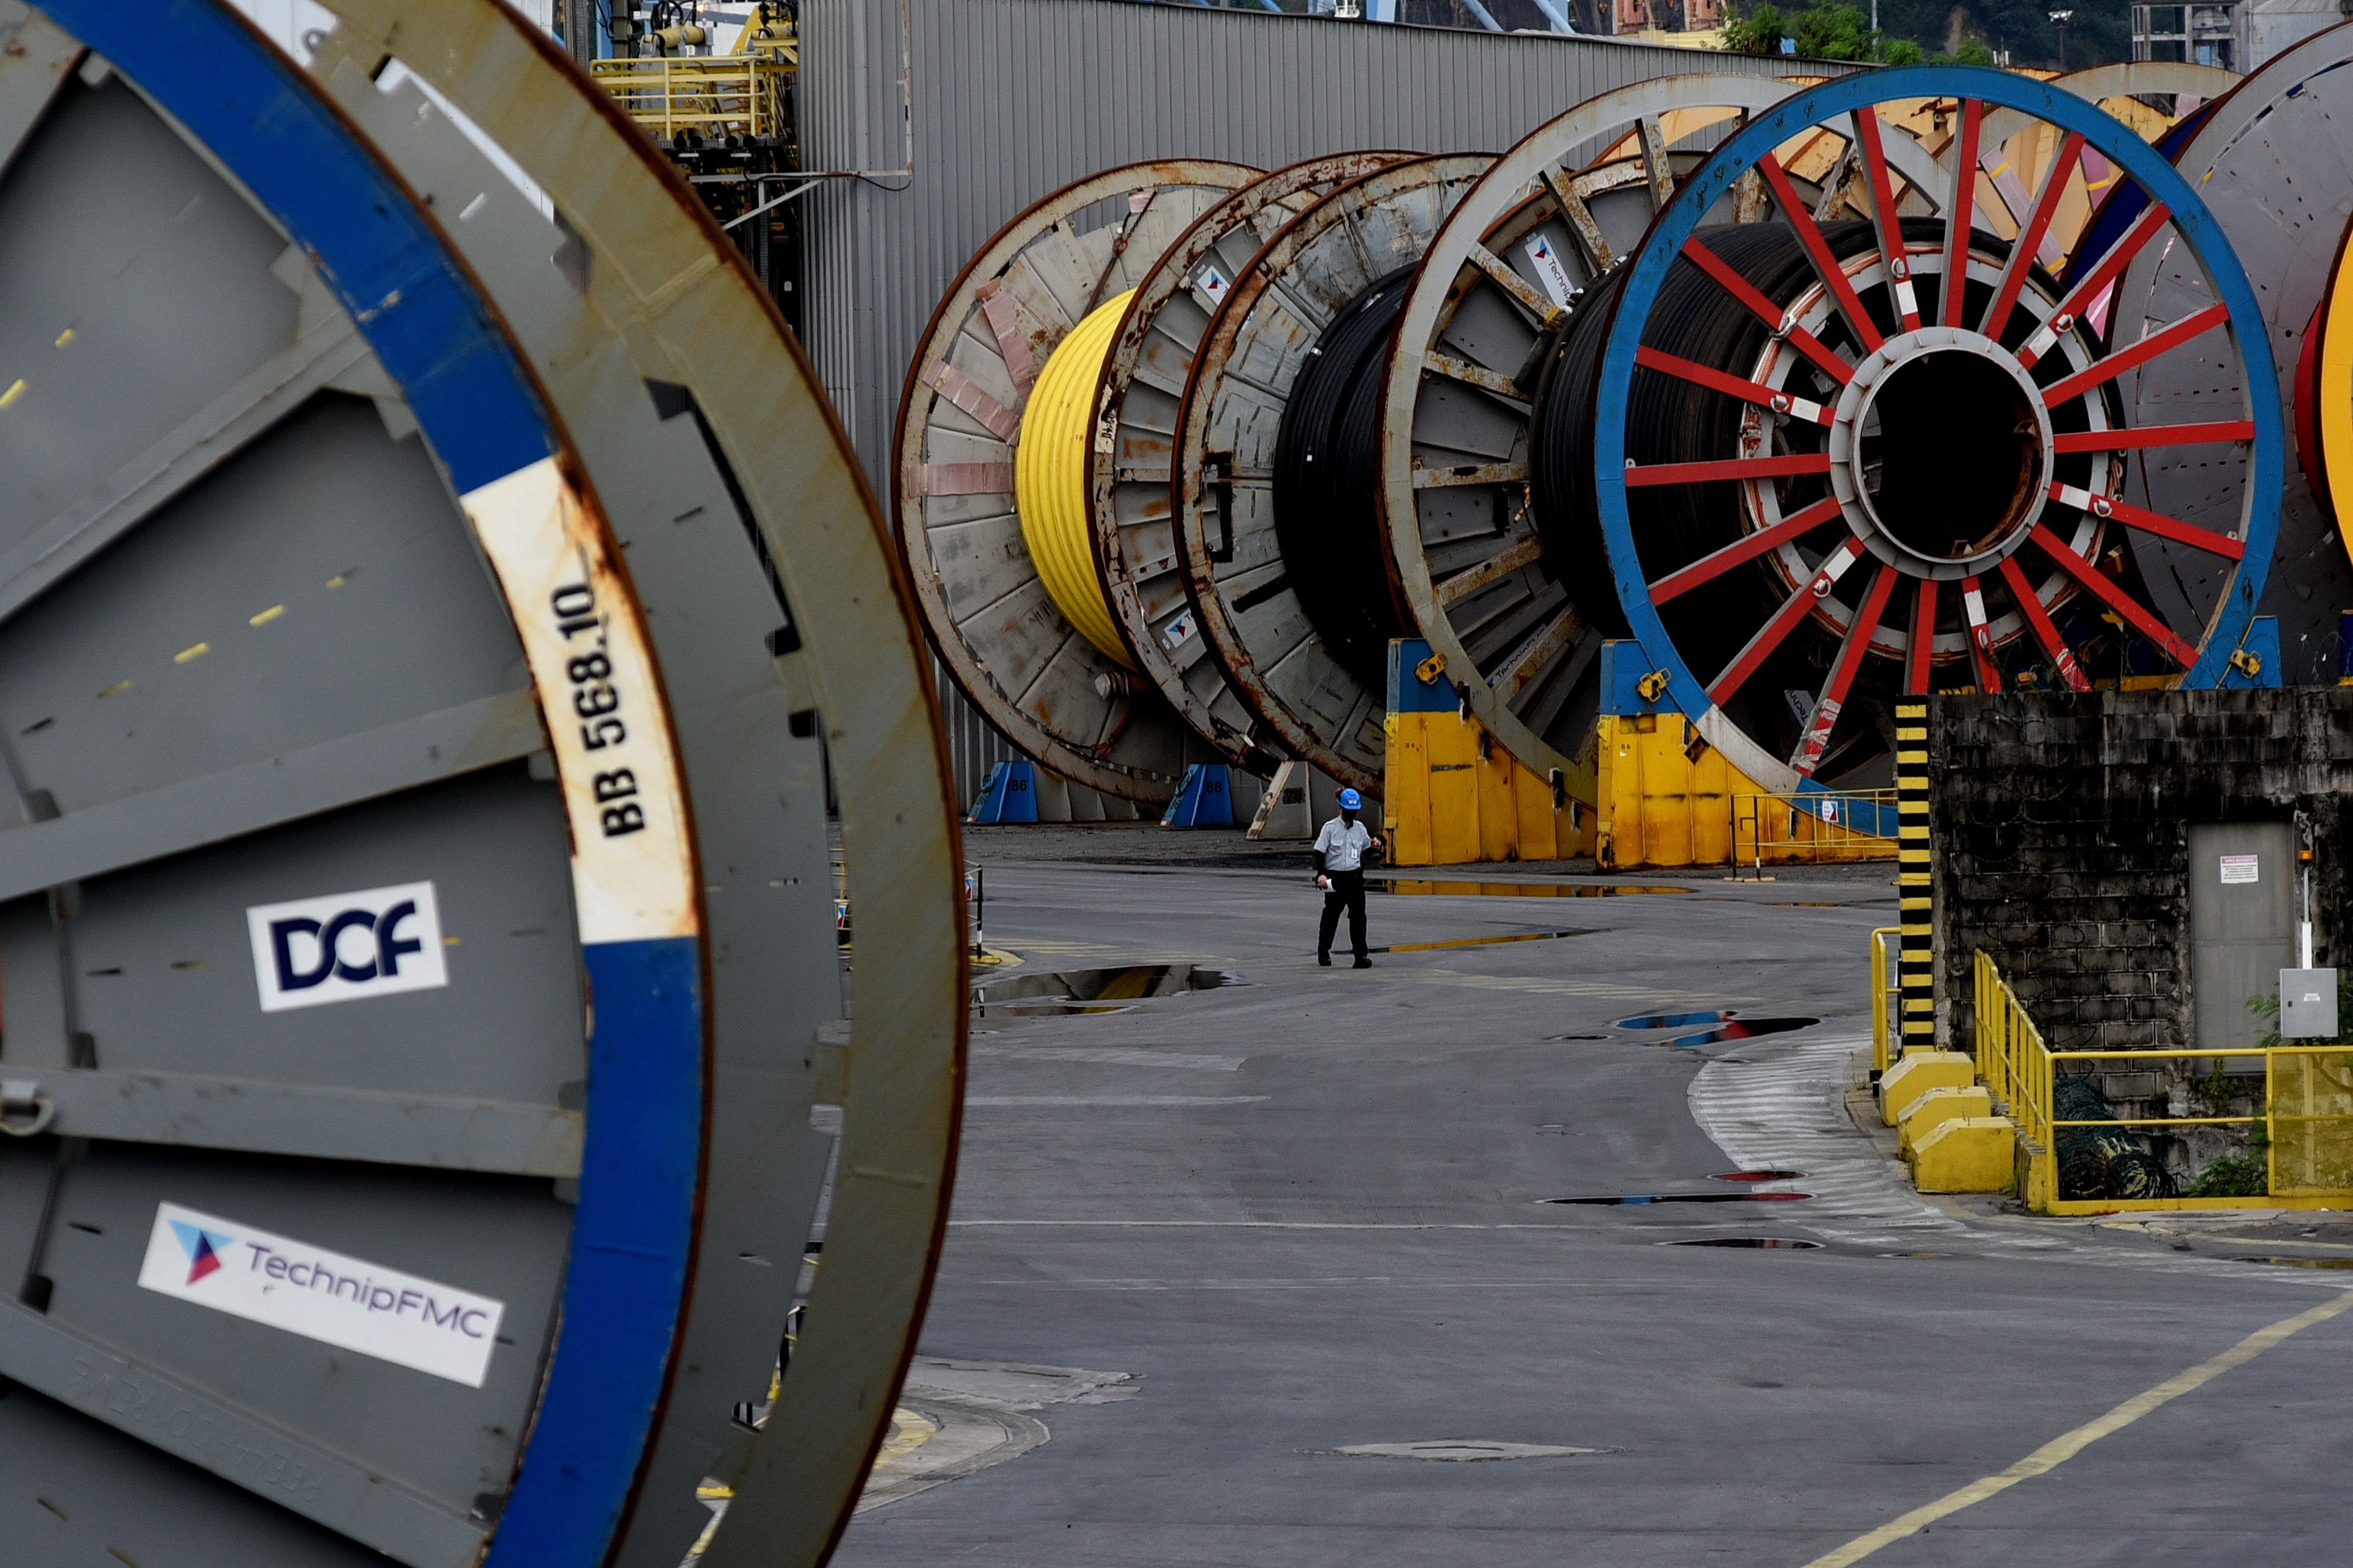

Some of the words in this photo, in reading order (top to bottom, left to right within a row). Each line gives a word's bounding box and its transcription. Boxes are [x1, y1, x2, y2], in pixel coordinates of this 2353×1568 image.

[551, 583, 626, 752] 568.10
[592, 765, 646, 839] BB
[1011, 779, 1028, 792] 86
[1206, 781, 1222, 793] 86
[267, 898, 421, 992] DOF
[244, 1241, 488, 1340] TechnipFMC
